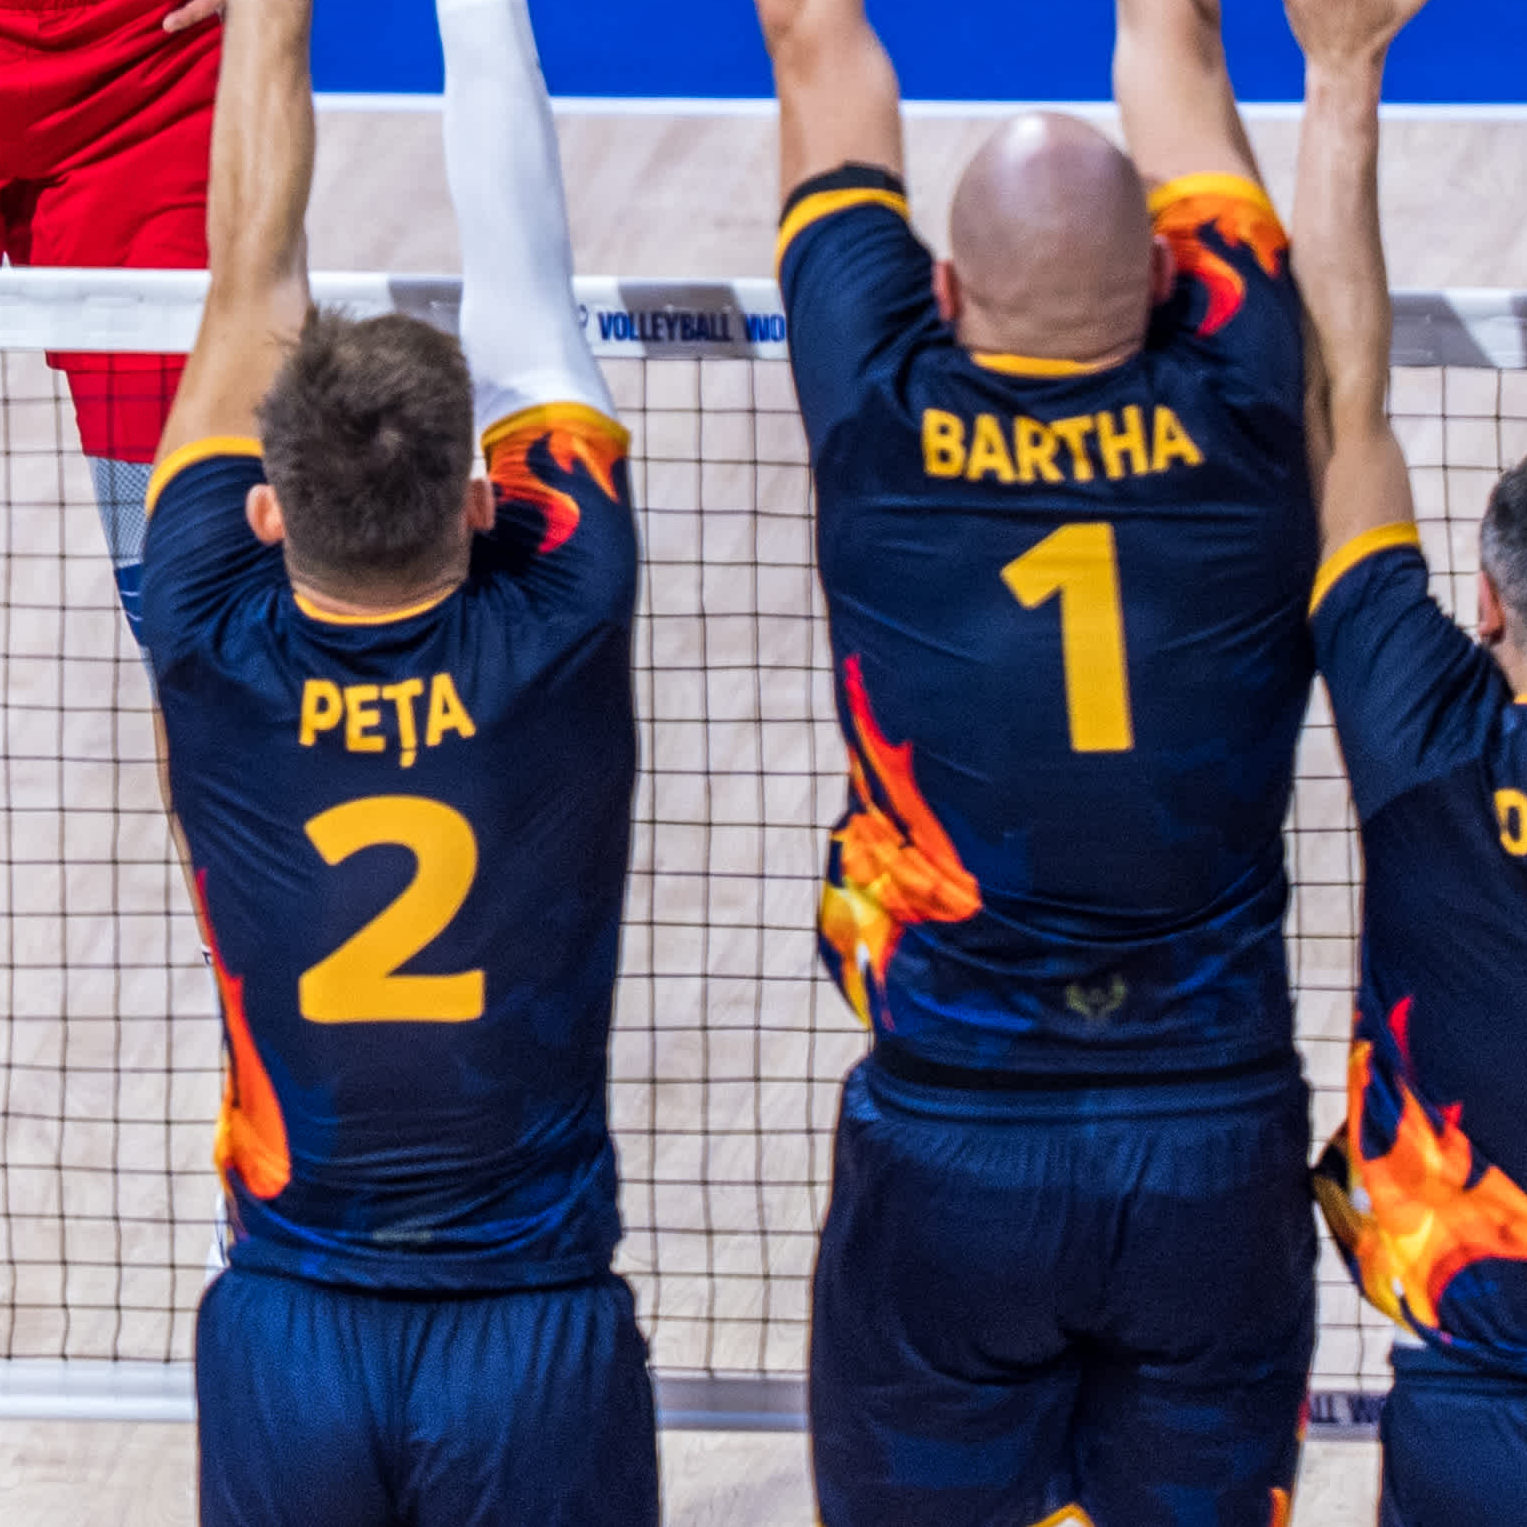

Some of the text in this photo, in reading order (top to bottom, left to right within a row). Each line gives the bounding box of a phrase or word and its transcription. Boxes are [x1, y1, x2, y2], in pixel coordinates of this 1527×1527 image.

[597, 311, 733, 343] VOLLEYBALL
[923, 406, 1200, 482] BARTHA
[1003, 522, 1131, 752] 1
[299, 795, 484, 1023] 2
